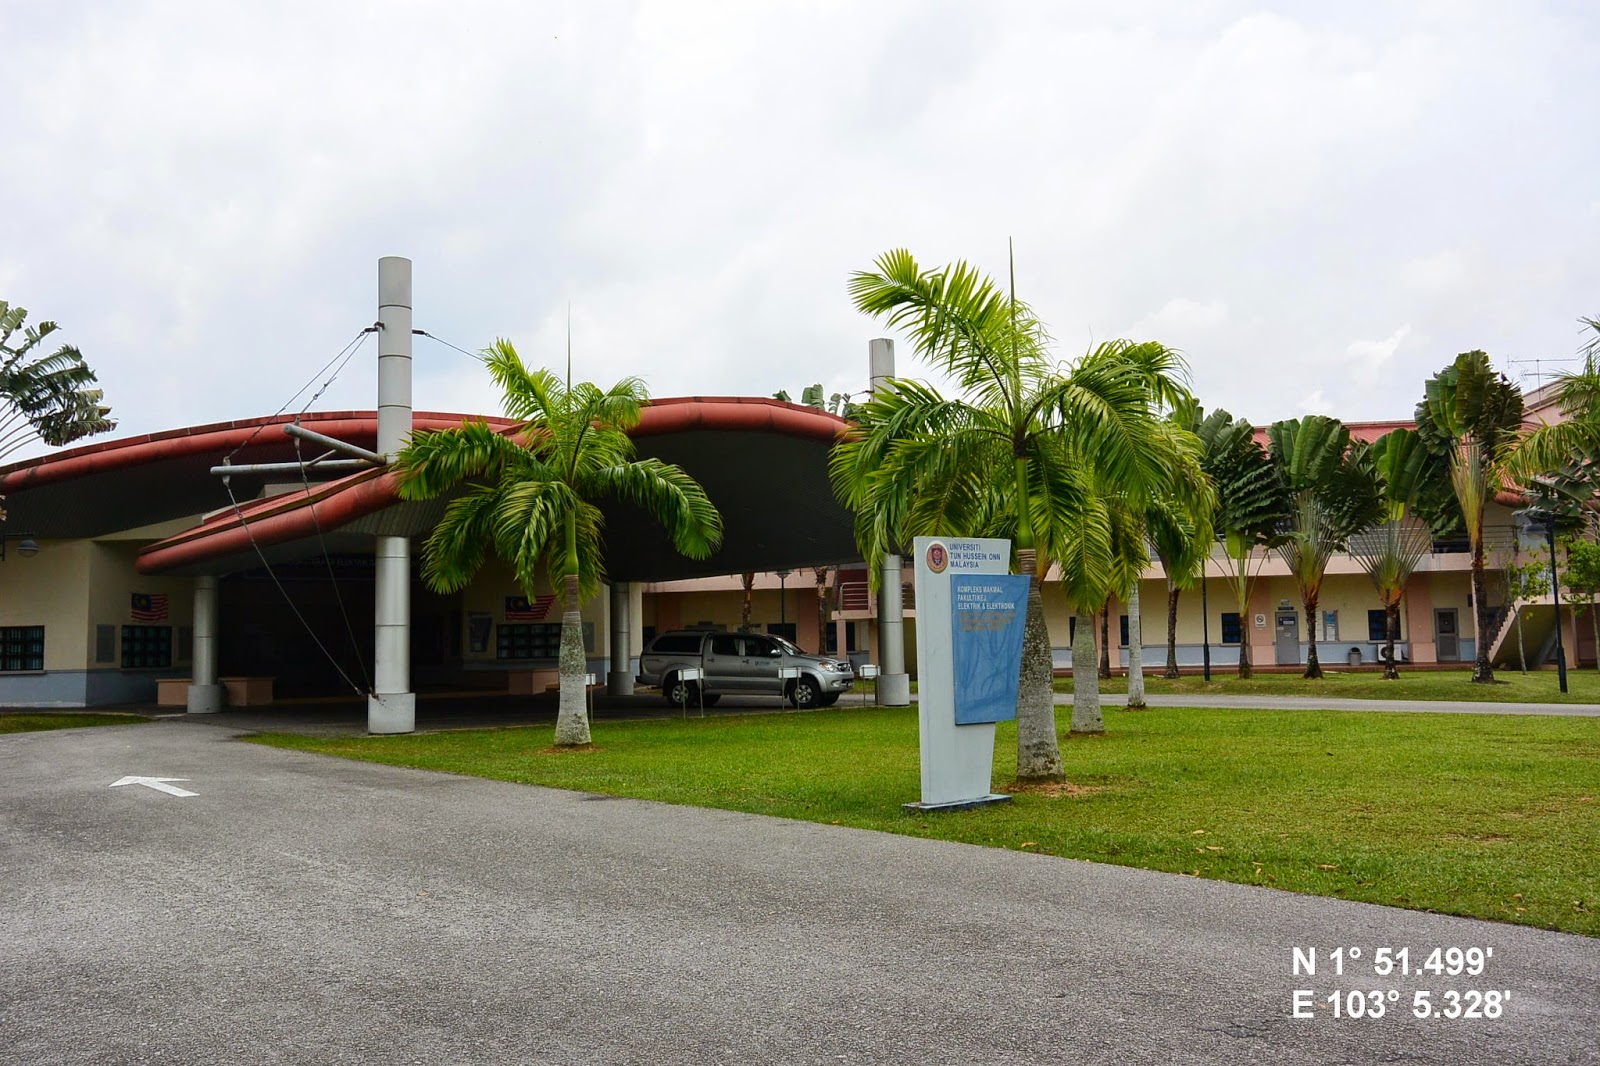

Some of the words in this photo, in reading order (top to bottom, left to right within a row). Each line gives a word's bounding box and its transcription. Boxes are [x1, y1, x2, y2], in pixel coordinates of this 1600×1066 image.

[949, 543, 981, 551] UNIVERSITI
[950, 552, 961, 560] TUN
[963, 552, 987, 561] HUSSEIN
[988, 553, 1001, 561] ONN
[950, 561, 979, 569] MALAYSIA
[957, 585, 982, 593] KOMPLEKS
[983, 586, 1003, 594] MAKMAL
[957, 594, 976, 602] FAKULTI
[958, 602, 981, 610] ELEKTRIK
[986, 603, 1015, 611] ELEKTRONIK
